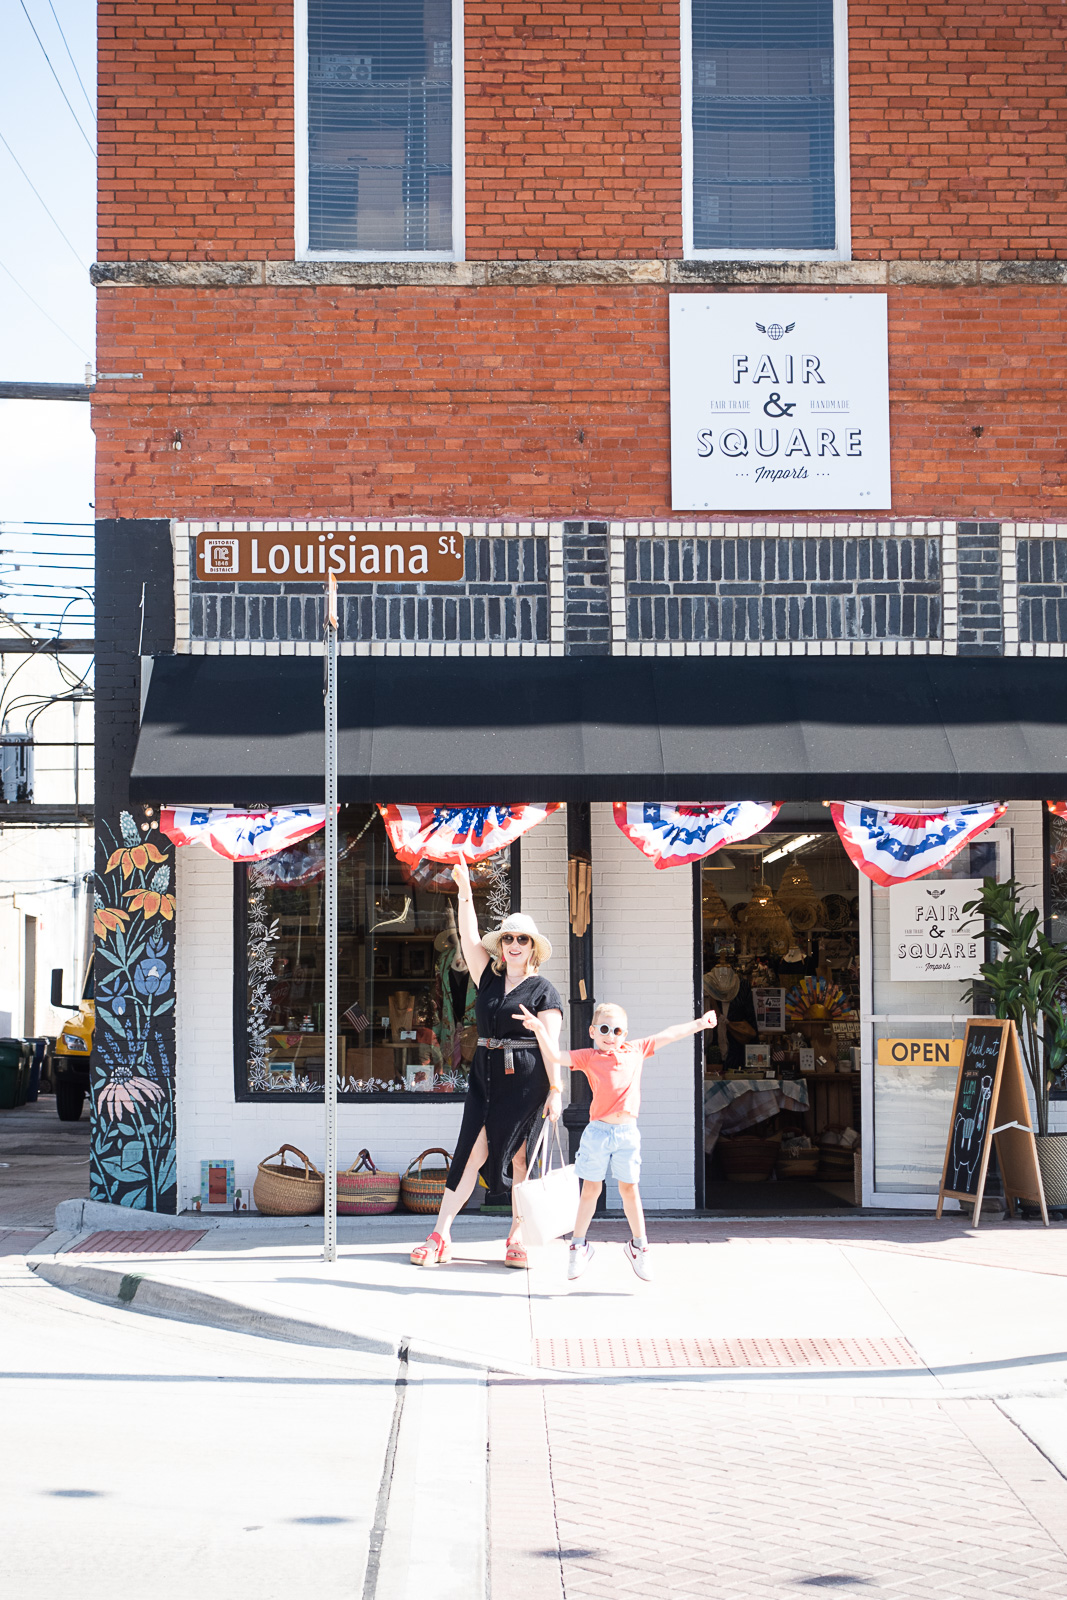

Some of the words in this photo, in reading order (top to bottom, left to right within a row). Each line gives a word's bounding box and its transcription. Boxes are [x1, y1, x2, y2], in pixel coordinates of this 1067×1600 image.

[732, 354, 826, 384] FAIR
[710, 400, 726, 409] FAIR
[729, 400, 751, 409] TRADE
[763, 392, 797, 418] &
[810, 400, 850, 409] HANDMADE
[696, 428, 863, 458] SQUARE
[755, 466, 810, 483] Imports
[251, 534, 429, 575] Louisiana
[915, 905, 960, 922] FAIR
[929, 924, 946, 939] &
[898, 943, 977, 959] SQUARE
[925, 962, 951, 972] Imports
[891, 1042, 950, 1062] OPEN
